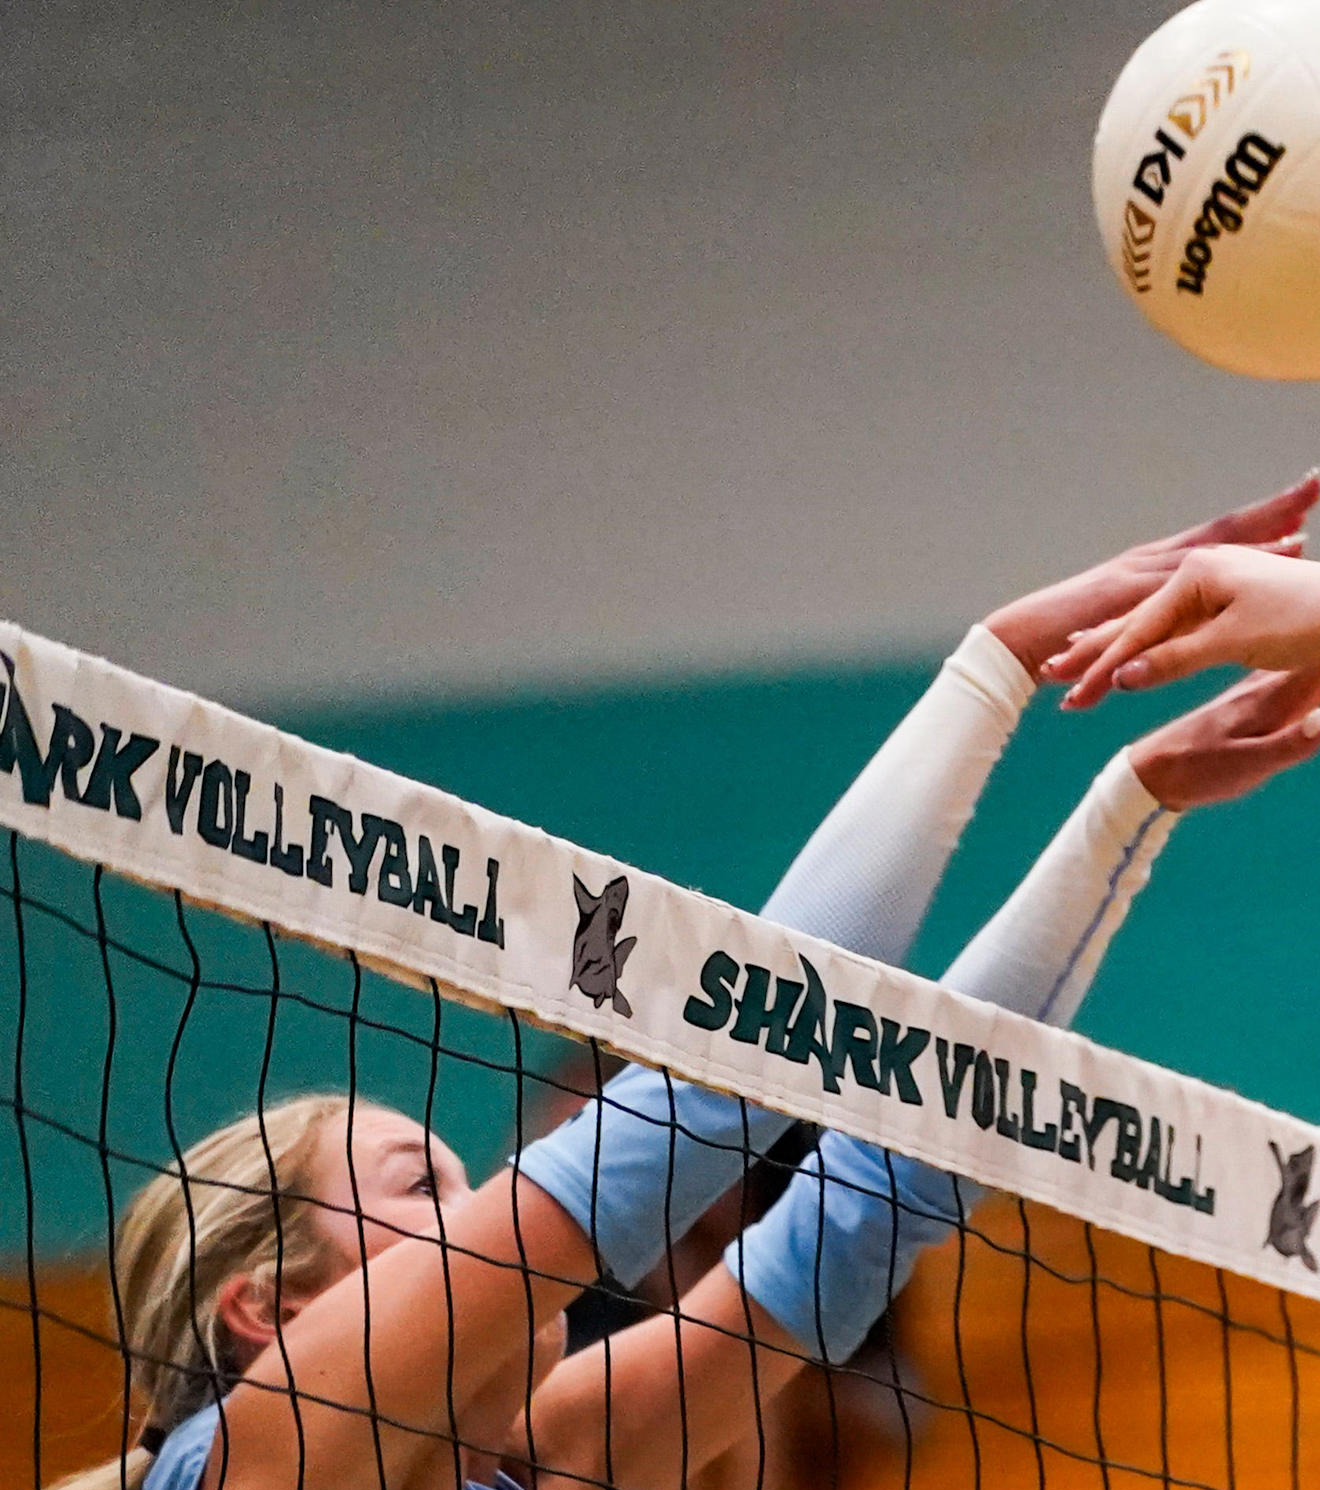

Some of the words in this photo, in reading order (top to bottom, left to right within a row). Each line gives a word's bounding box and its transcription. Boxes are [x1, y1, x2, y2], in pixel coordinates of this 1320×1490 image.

[1176, 131, 1287, 297] Wilson
[0, 650, 160, 822] ARK
[166, 745, 505, 949] VOLLEYBALL
[683, 950, 931, 1106] SHARK
[934, 1036, 1216, 1216] VOLLEYBALL
